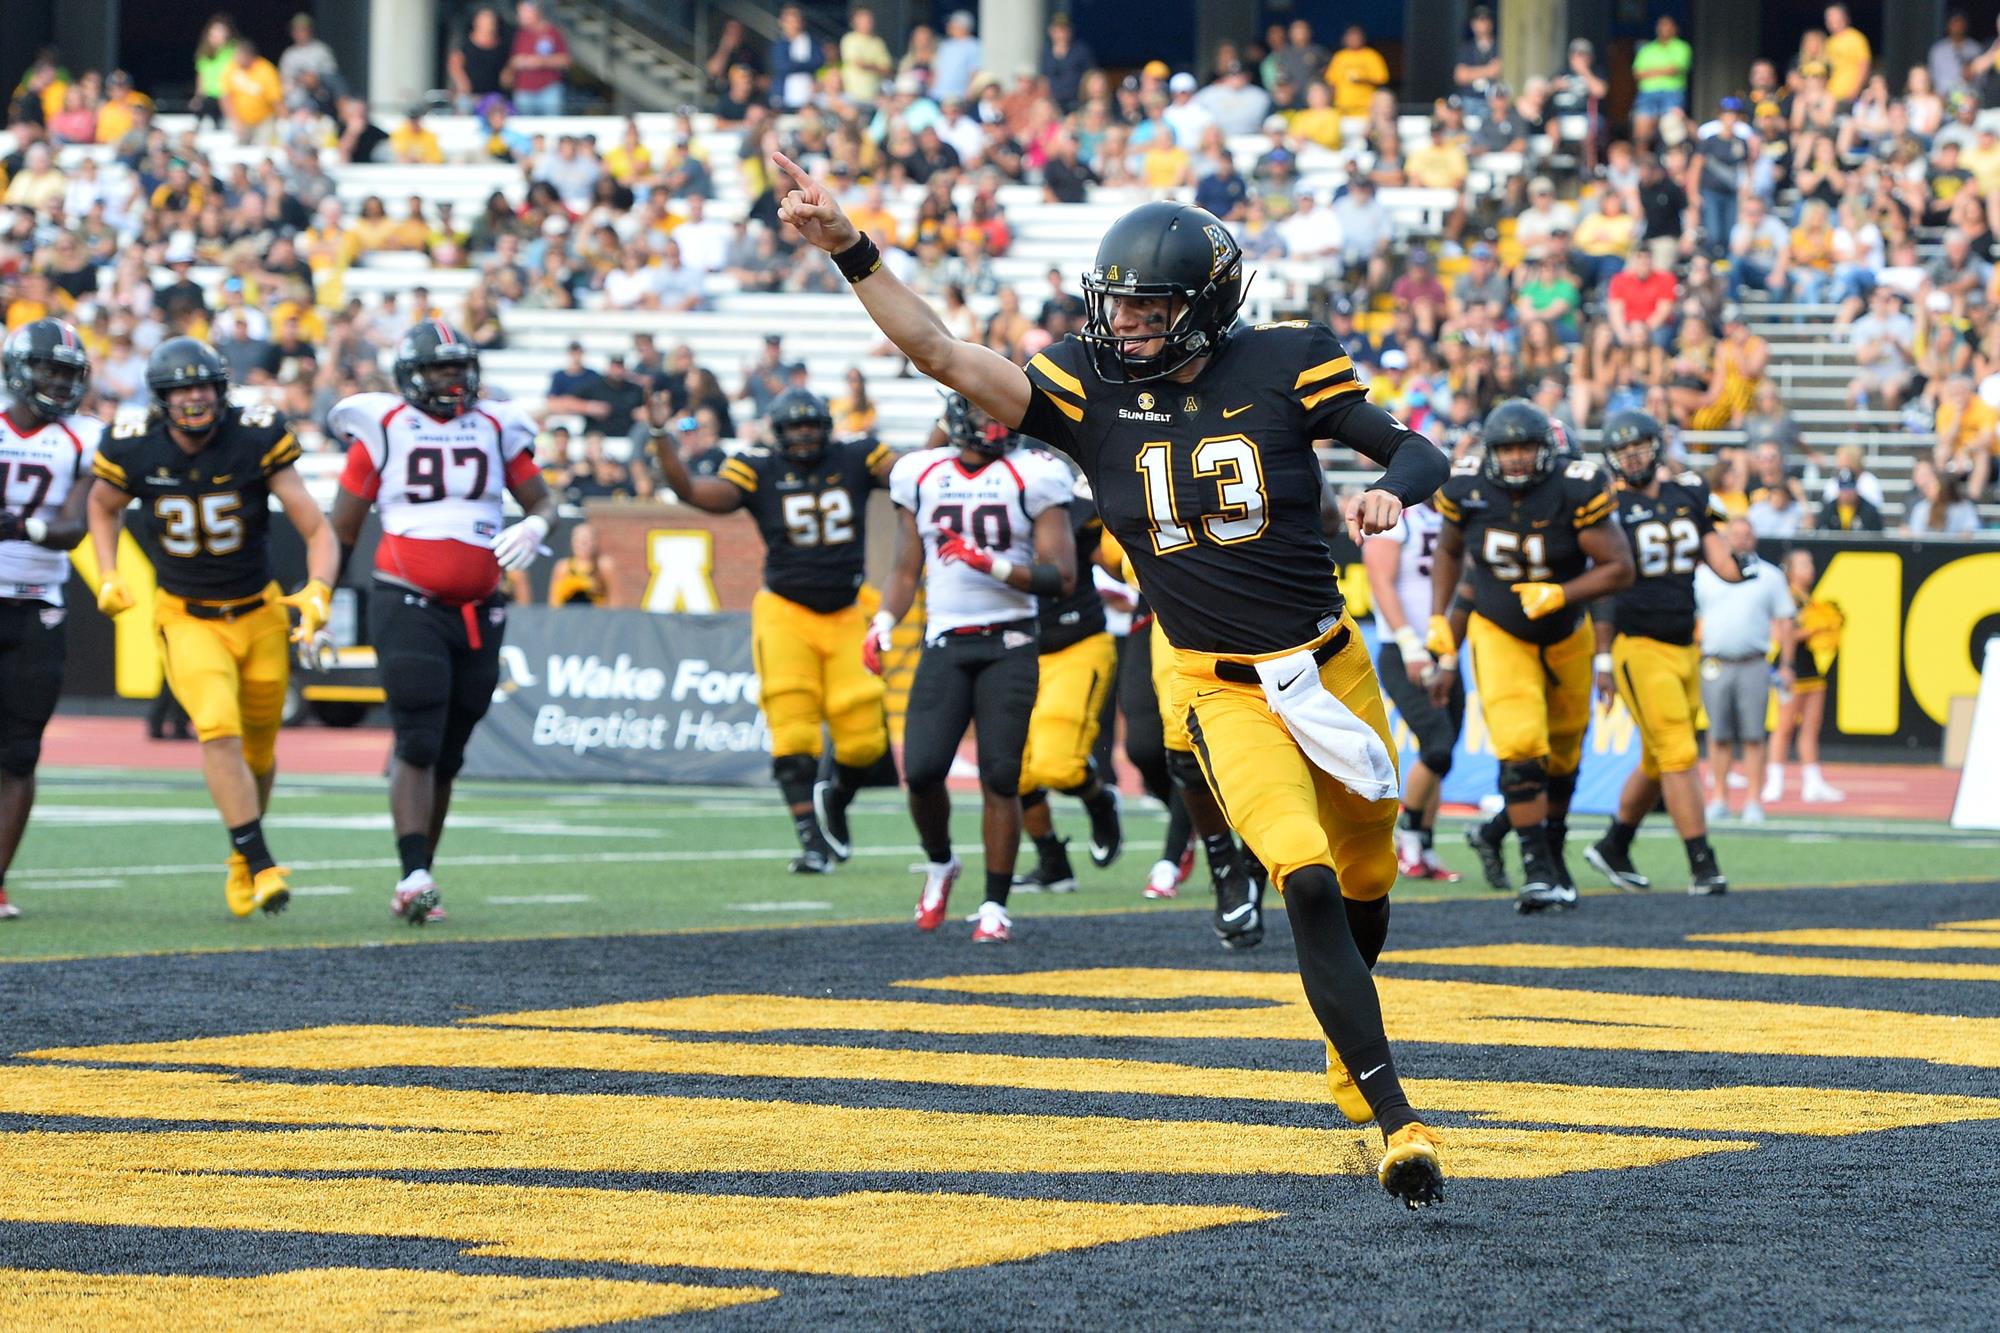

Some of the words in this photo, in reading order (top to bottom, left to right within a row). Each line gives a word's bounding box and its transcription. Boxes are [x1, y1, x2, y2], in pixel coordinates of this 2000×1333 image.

[1107, 265, 1119, 281] A
[1184, 396, 1198, 412] A
[405, 447, 489, 504] 97
[1135, 433, 1270, 556] 13
[154, 491, 246, 558] 35
[782, 487, 857, 547] 52
[641, 528, 721, 615] A
[1484, 528, 1552, 581] 51
[1635, 518, 1700, 576] 62
[547, 653, 666, 701] Wake
[671, 659, 762, 704] Fore
[532, 704, 669, 756] Baptist
[674, 709, 774, 752] Heal
